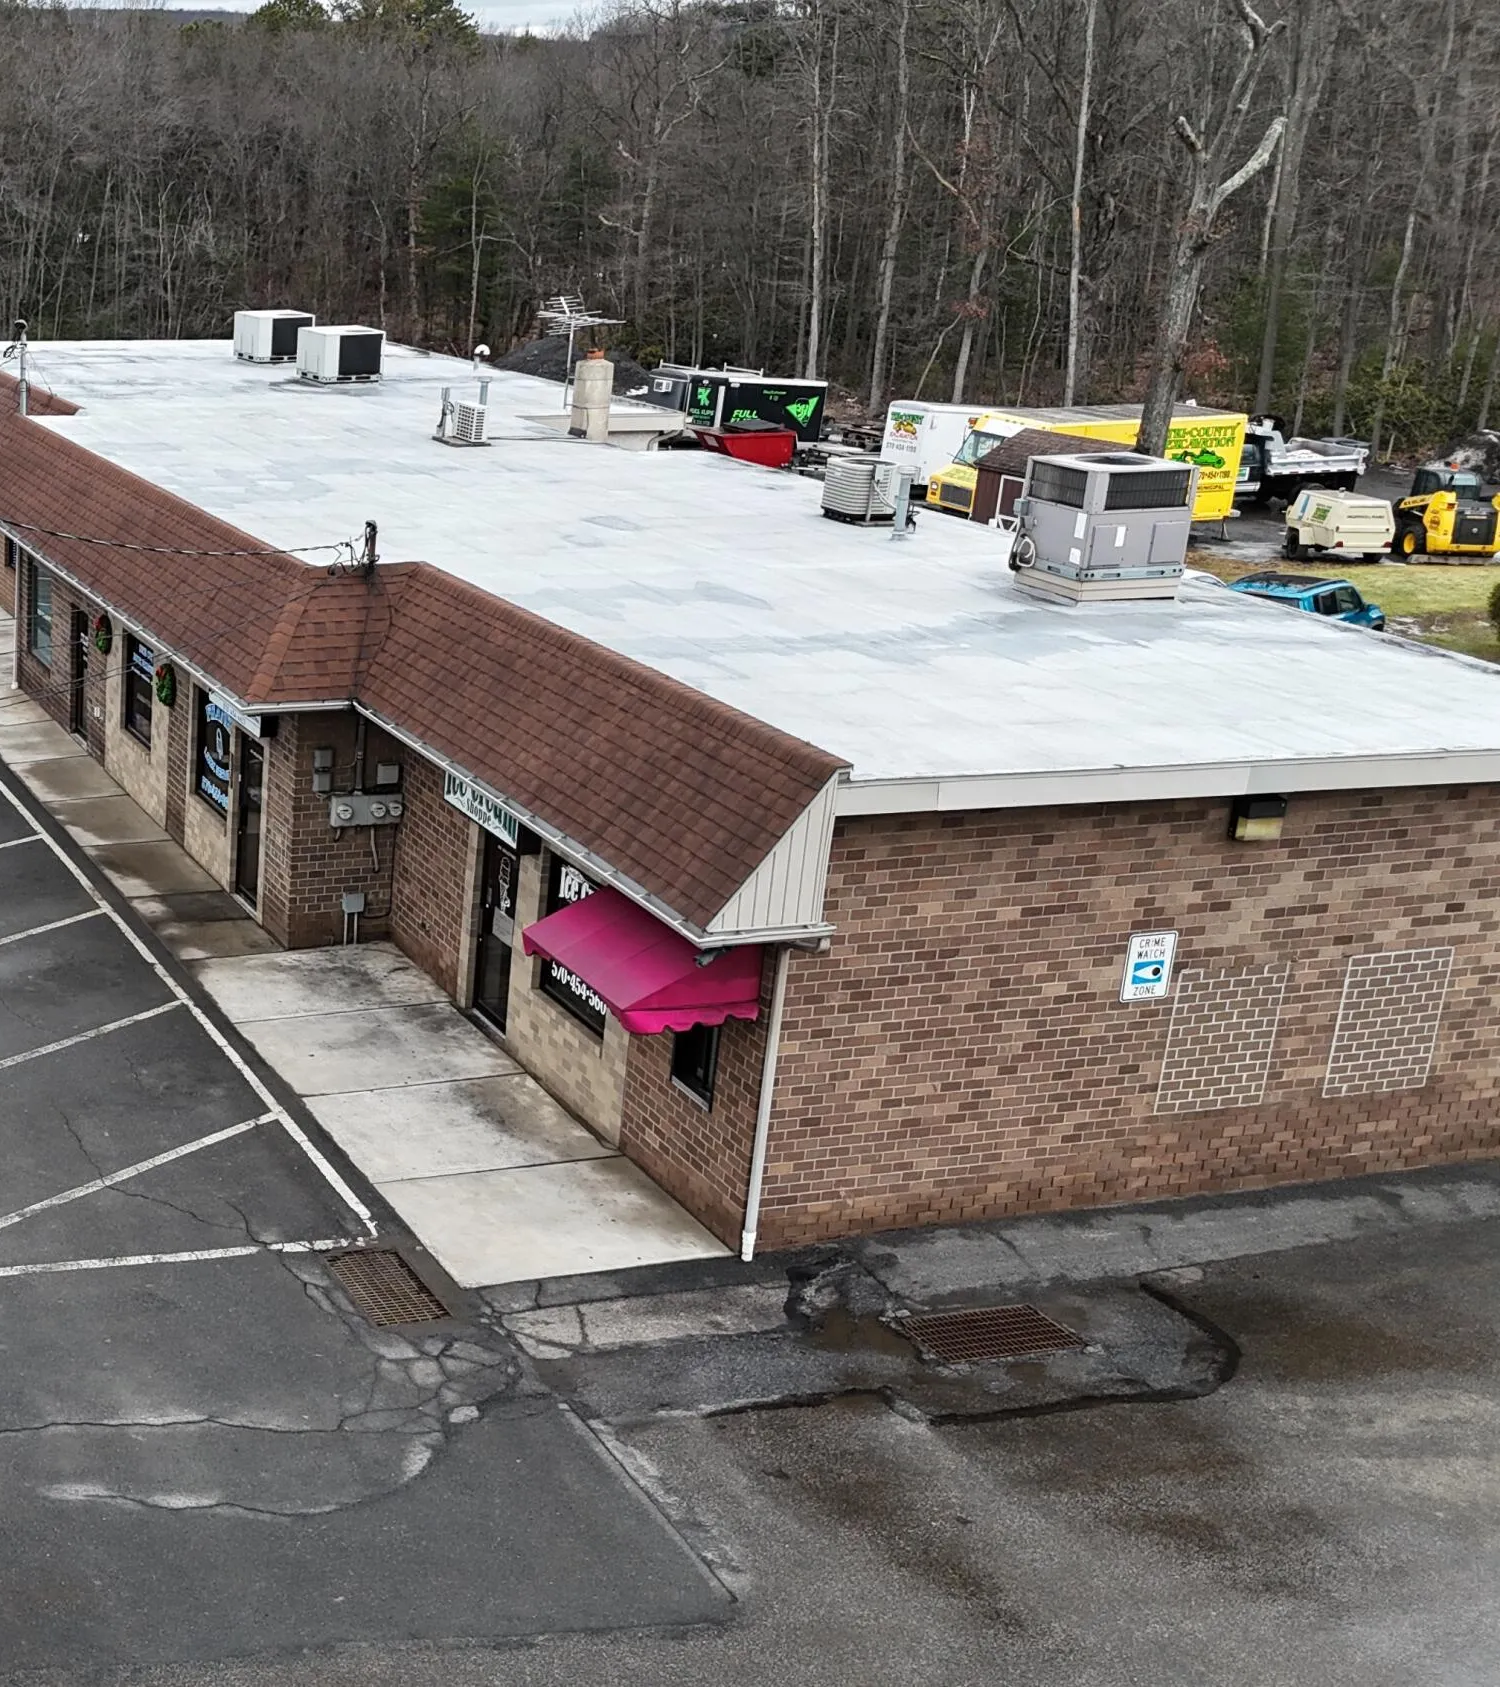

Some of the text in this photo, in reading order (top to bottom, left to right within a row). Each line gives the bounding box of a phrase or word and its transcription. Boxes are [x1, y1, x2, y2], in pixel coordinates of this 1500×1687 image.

[732, 409, 758, 419] FULL
[466, 797, 492, 826] Shoppe
[558, 866, 579, 902] Ice
[1139, 937, 1166, 949] CRIME
[1137, 948, 1165, 960] WATCH
[1133, 985, 1157, 997] ZONE
